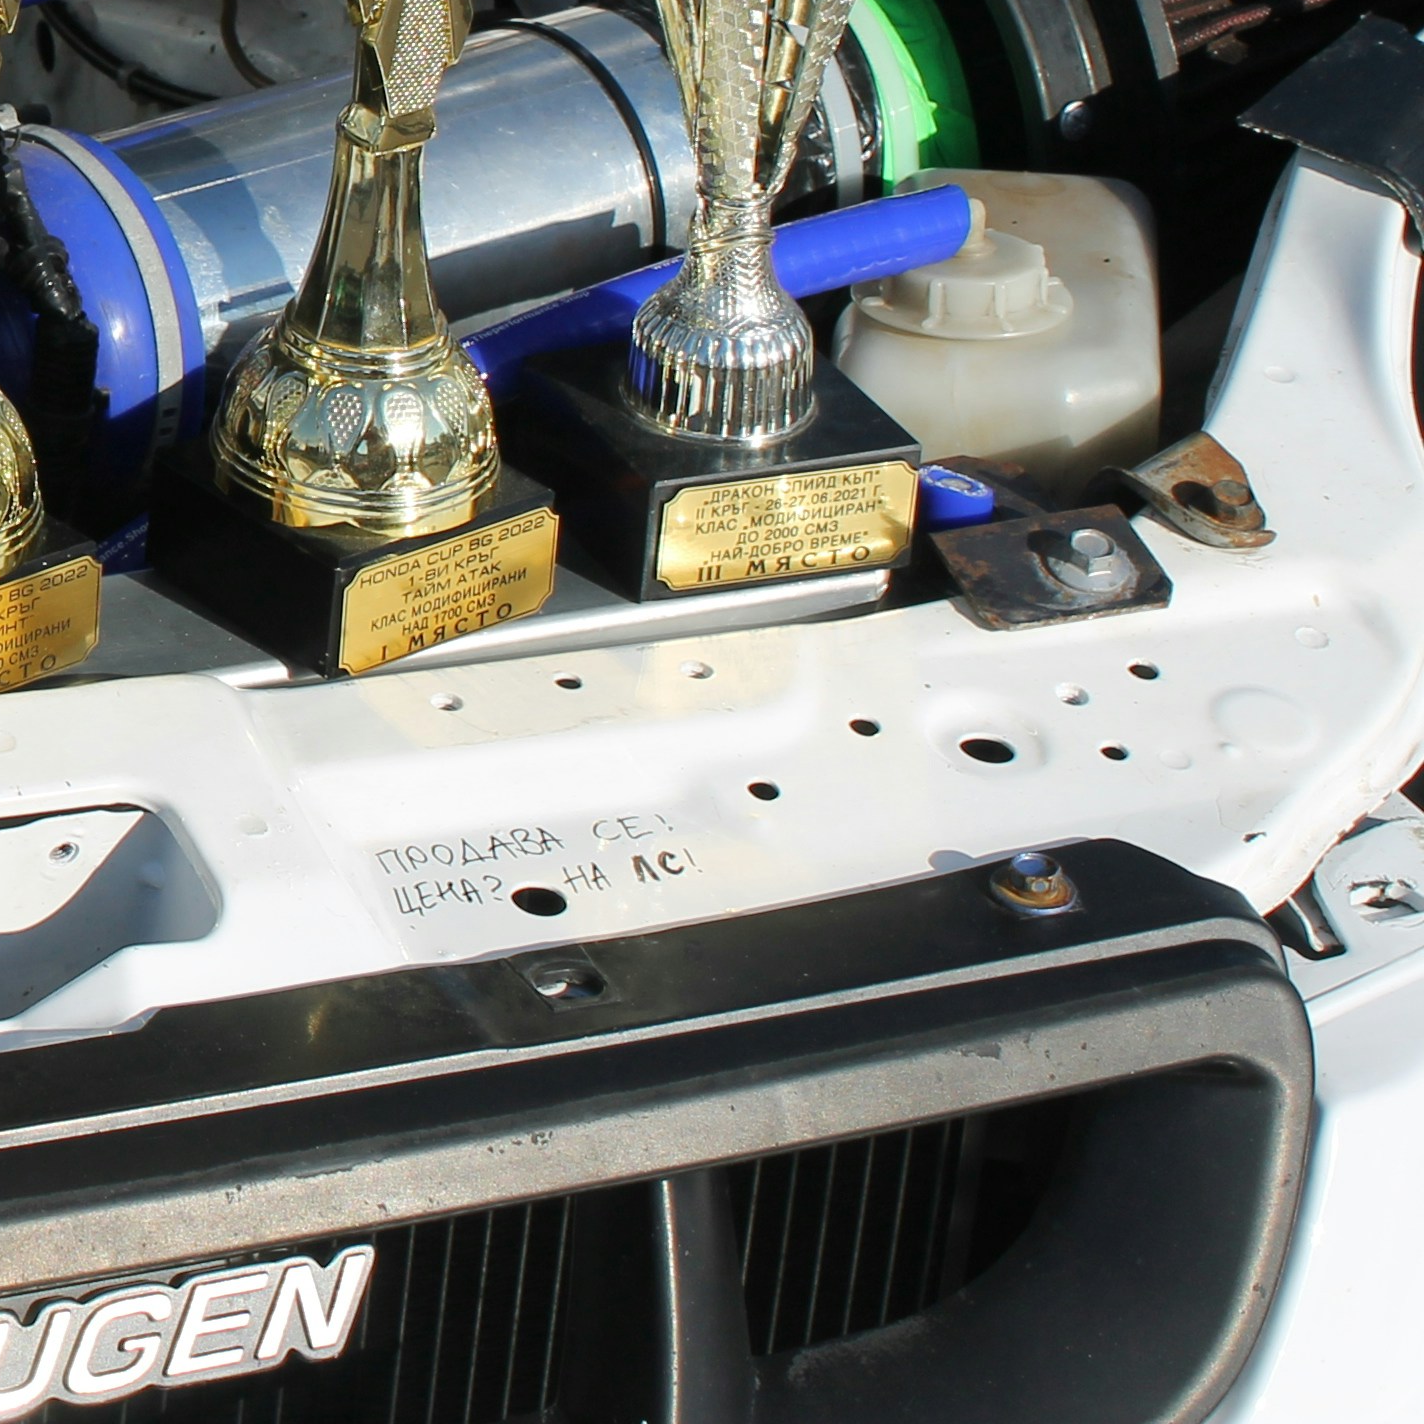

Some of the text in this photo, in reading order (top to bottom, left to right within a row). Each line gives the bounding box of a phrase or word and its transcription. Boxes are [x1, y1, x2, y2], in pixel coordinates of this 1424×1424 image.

[710, 501, 750, 519] КРЪГ
[765, 488, 867, 512] 26-27.06.2021
[695, 518, 738, 536] КЛАС
[735, 531, 759, 547] ДО
[764, 526, 799, 542] 2000
[359, 516, 545, 589] HONDA CUP BG 2022
[408, 546, 501, 587] 1-ВИ КРЪГ
[745, 545, 871, 578] МЯСТО
[8, 583, 34, 603] BG
[39, 565, 88, 592] 2022
[370, 567, 528, 632] КЛАС МОДИФИЦИРАНИ
[402, 560, 502, 604] ТАЙМ АТАК
[402, 617, 430, 636] НАД
[433, 605, 462, 626] 1700
[407, 602, 513, 652] МЯСТО
[375, 826, 564, 875] ПРОДАВА
[392, 874, 503, 917] ЦЕНА?
[562, 862, 611, 894] НА
